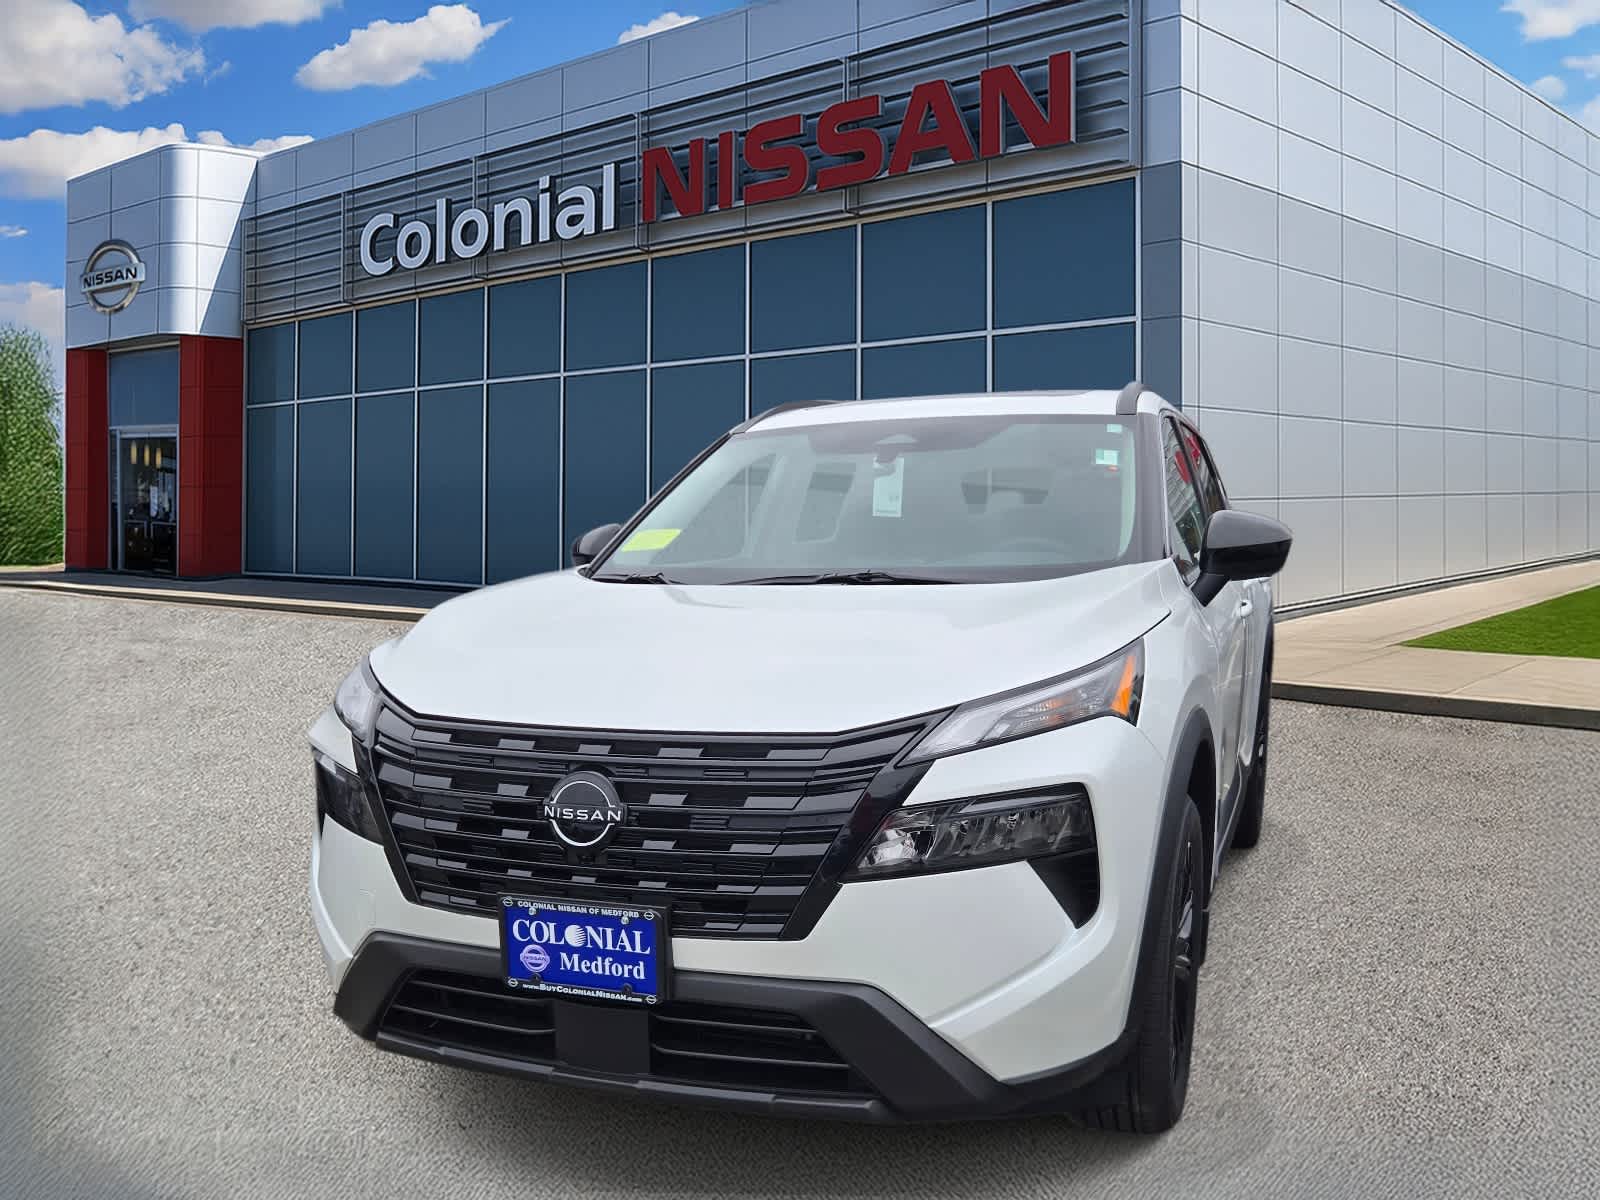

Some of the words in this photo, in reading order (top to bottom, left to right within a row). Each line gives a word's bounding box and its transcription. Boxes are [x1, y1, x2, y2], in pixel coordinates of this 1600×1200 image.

[360, 162, 619, 277] Colonial
[641, 51, 1077, 224] NISSAN
[83, 267, 137, 288] NISSAN
[544, 806, 621, 821] NISSAN
[517, 900, 557, 911] COLONIAL
[558, 905, 588, 914] NISSAN
[601, 909, 640, 918] MEDFORD
[512, 919, 650, 954] COLONIAL
[560, 952, 646, 980] Medford
